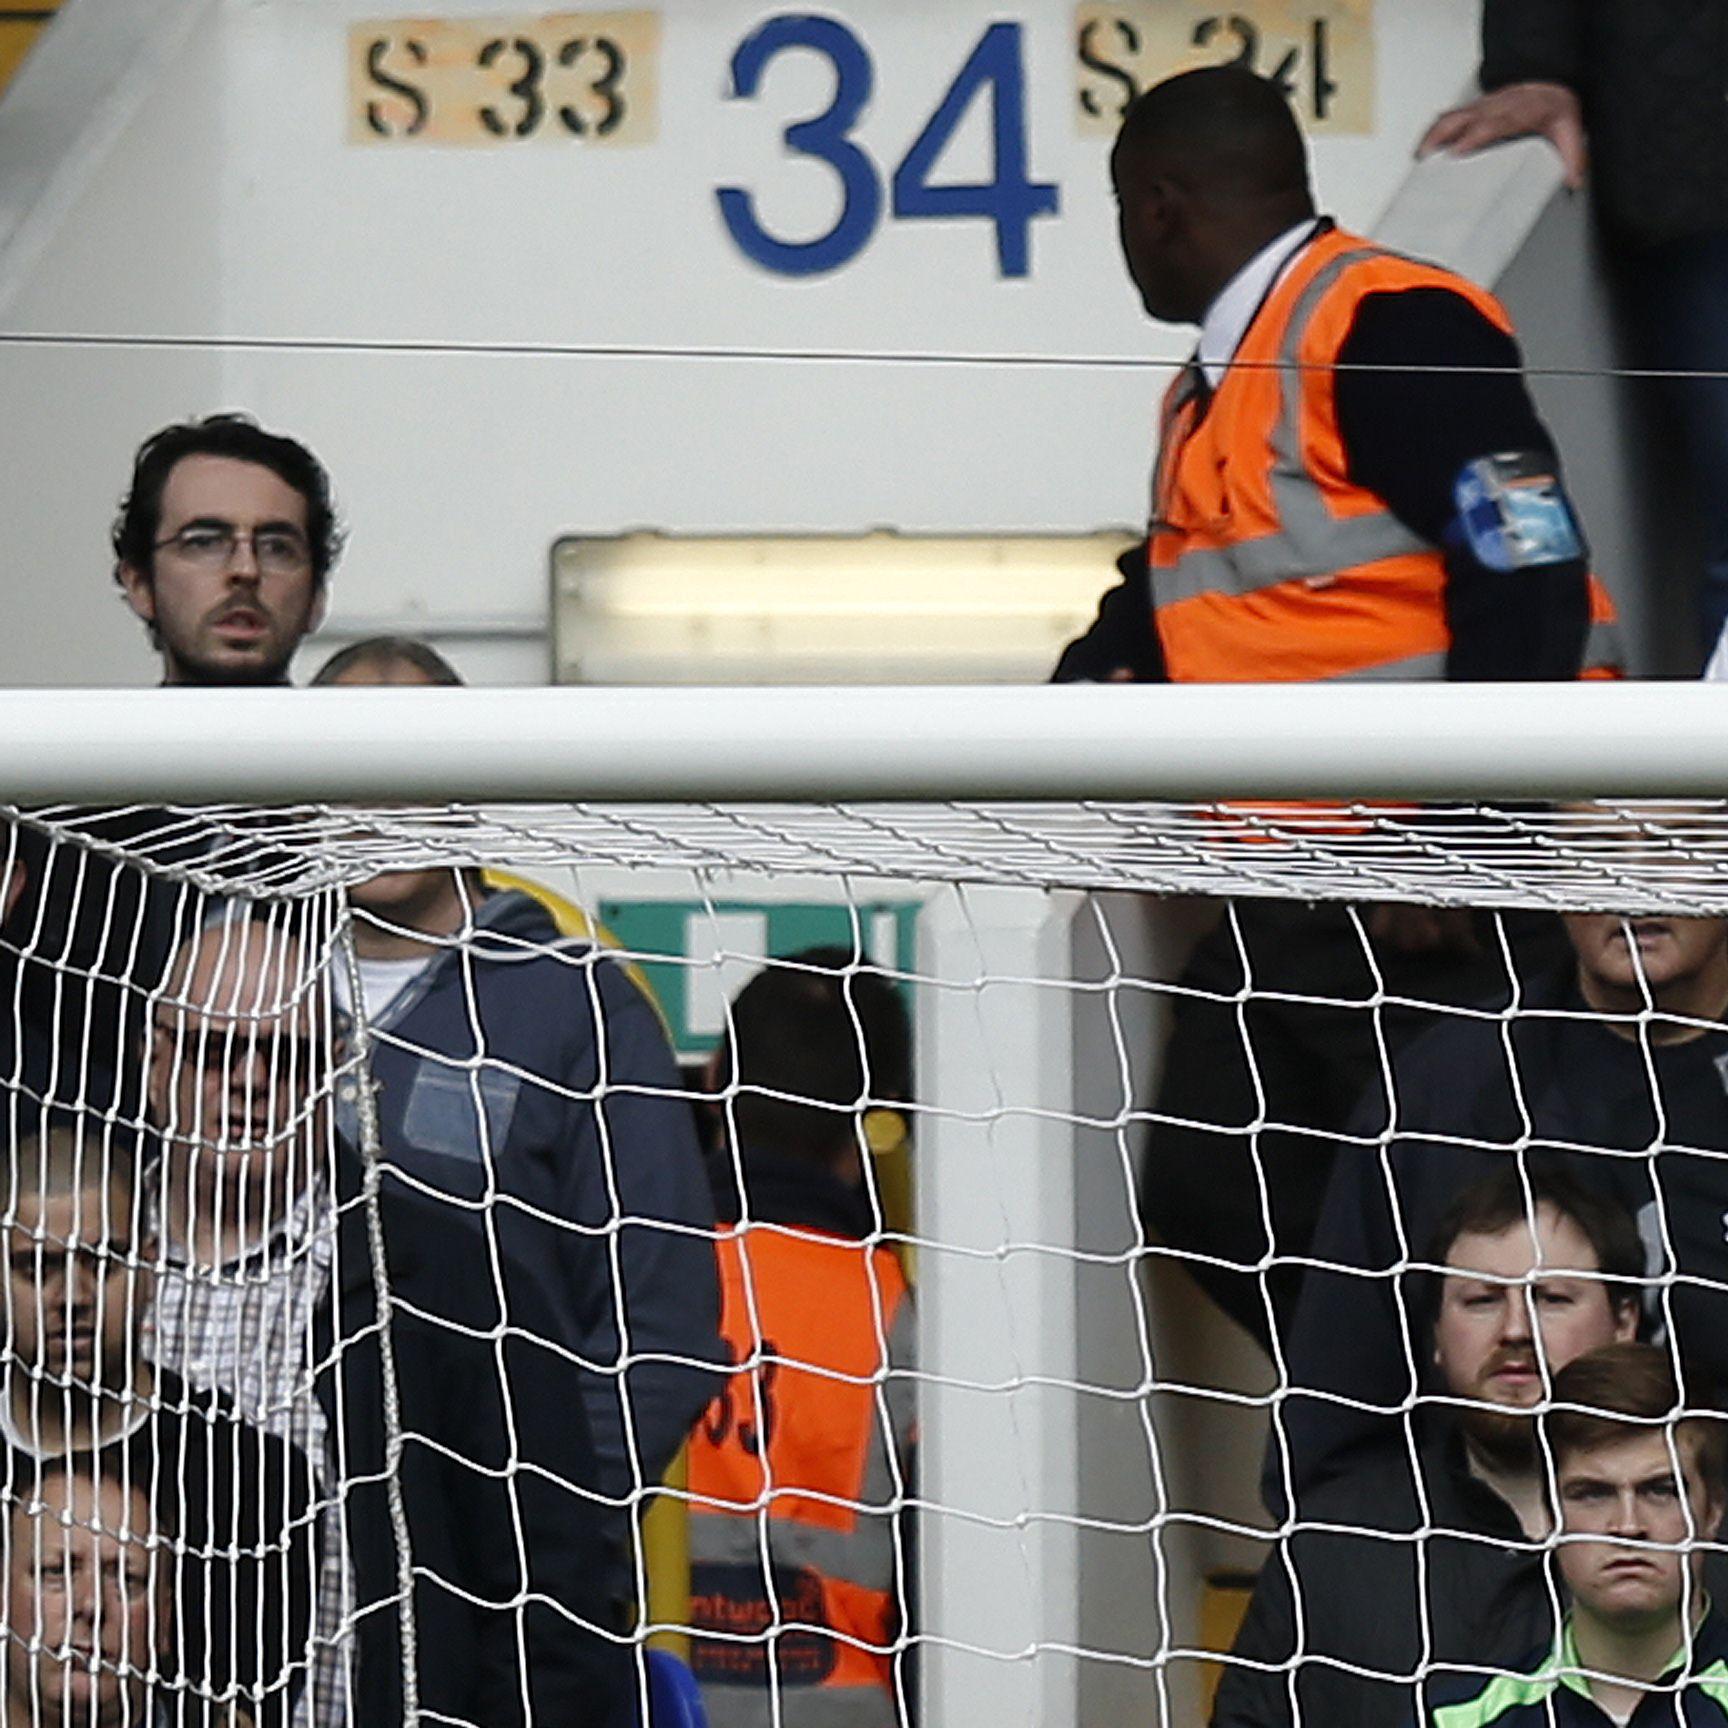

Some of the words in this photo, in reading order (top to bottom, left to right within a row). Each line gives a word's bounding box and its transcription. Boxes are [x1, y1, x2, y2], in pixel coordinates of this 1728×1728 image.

[365, 38, 428, 138] S
[476, 40, 627, 138] 33
[1077, 18, 1141, 118] S
[715, 13, 1061, 279] 34
